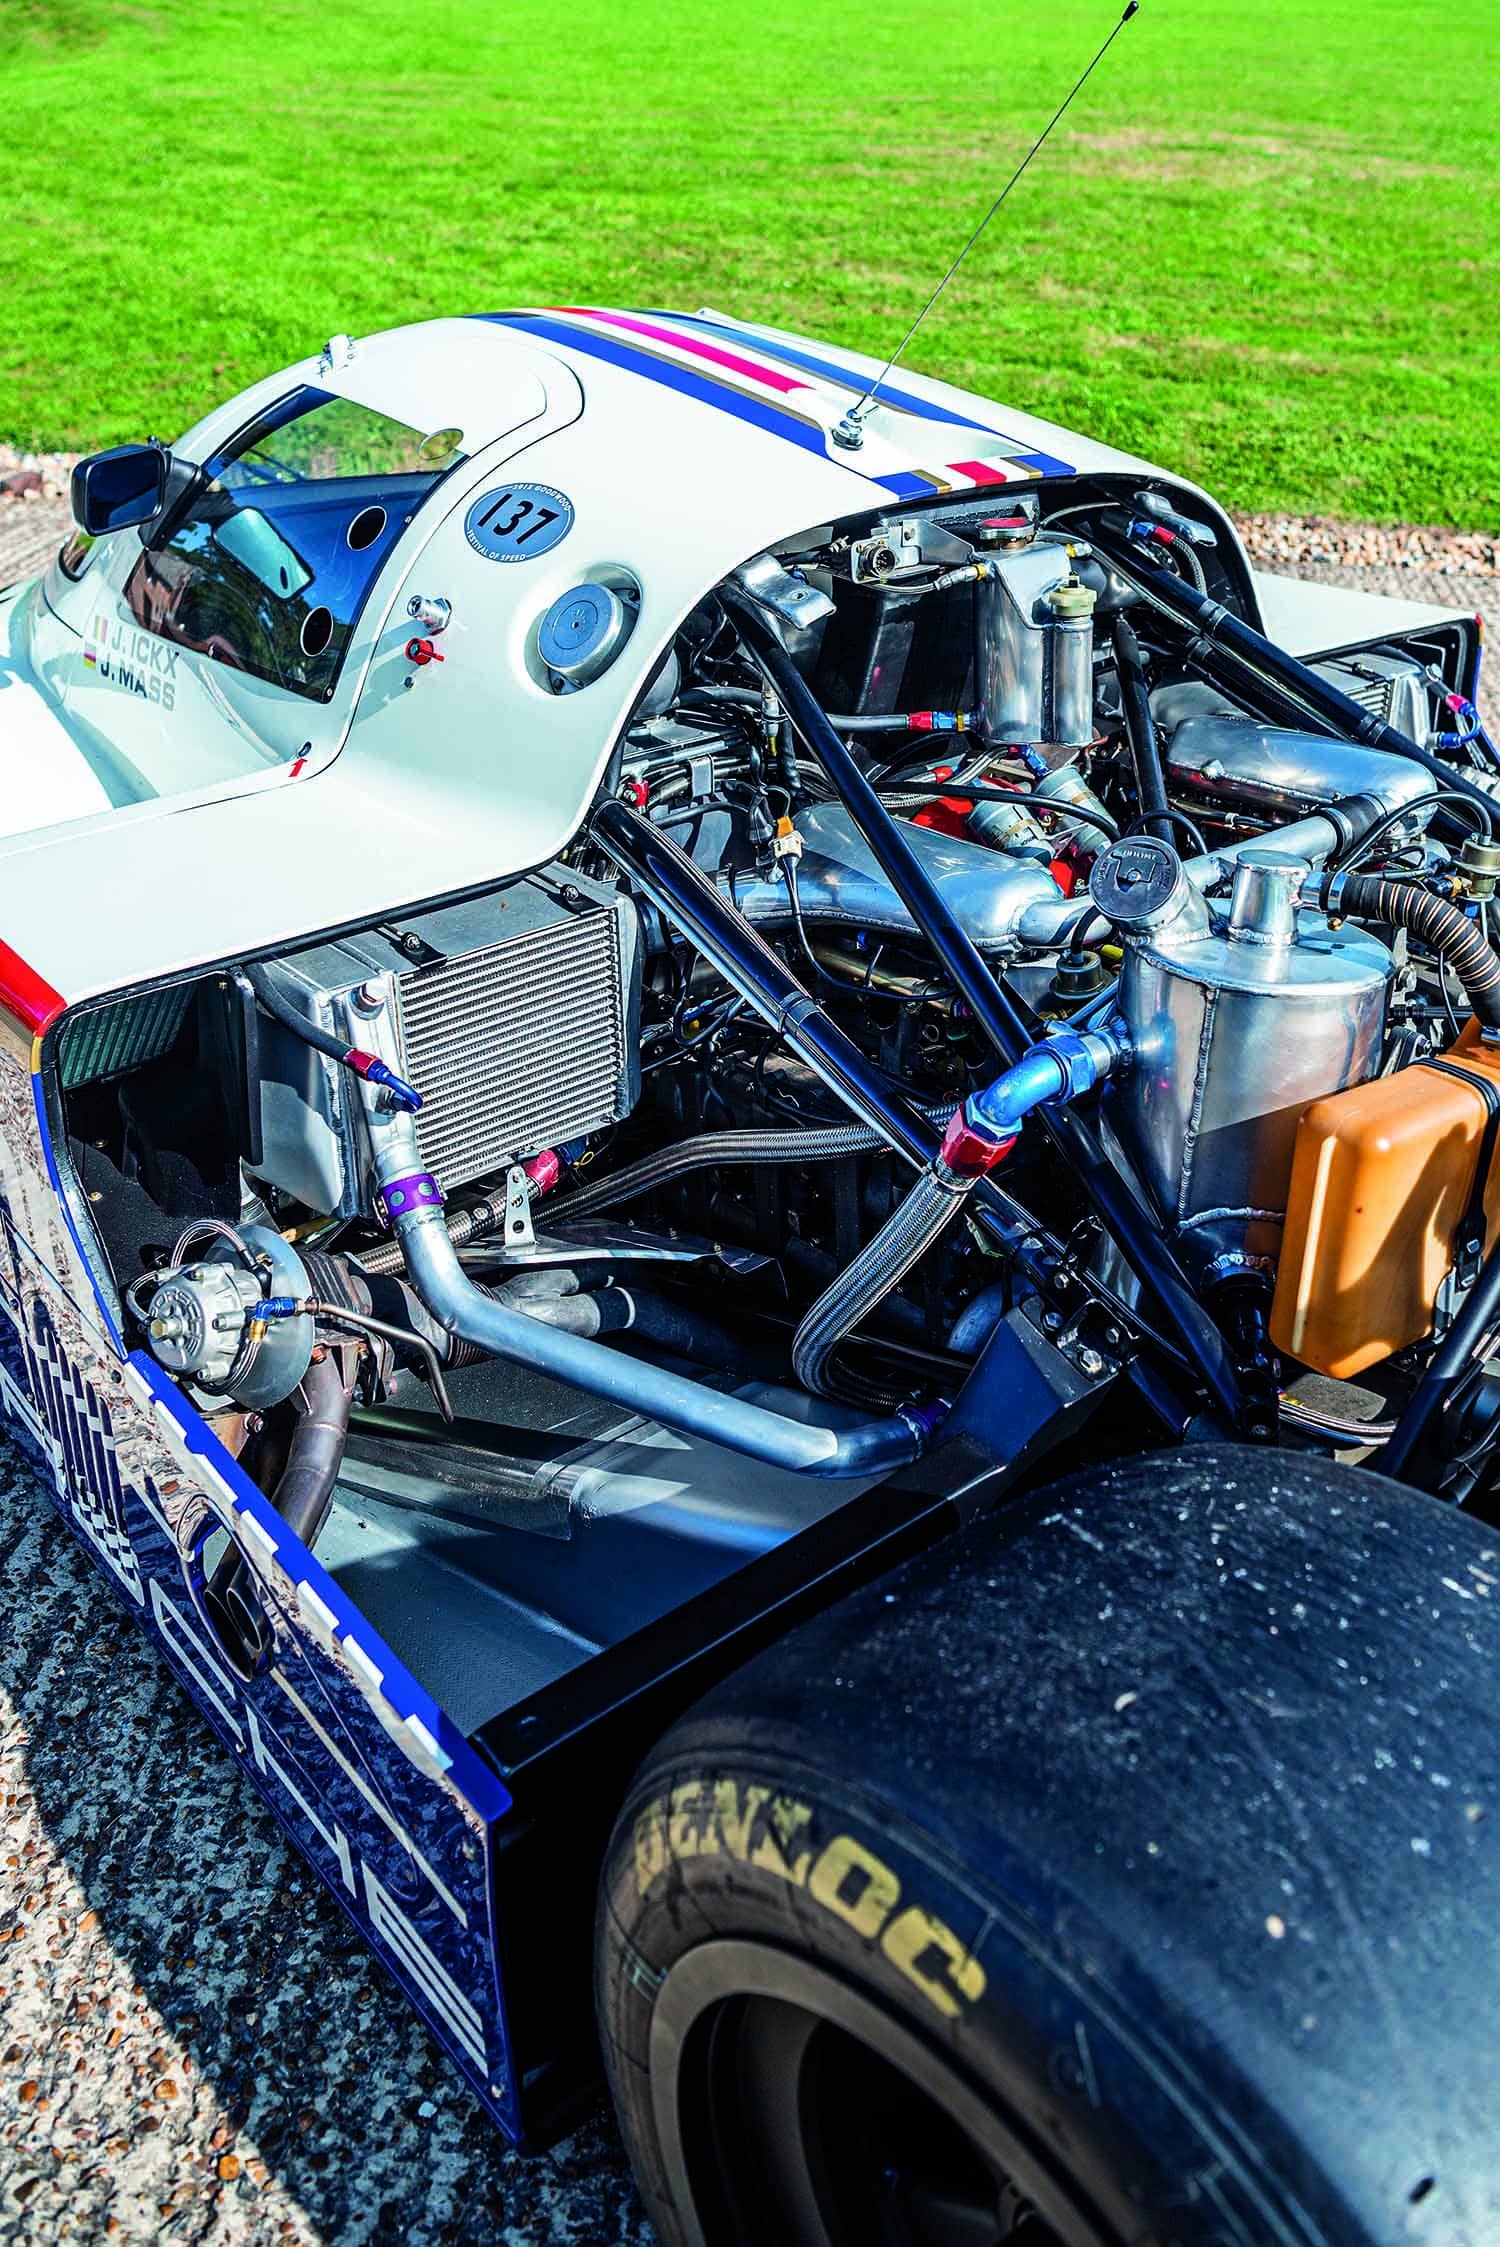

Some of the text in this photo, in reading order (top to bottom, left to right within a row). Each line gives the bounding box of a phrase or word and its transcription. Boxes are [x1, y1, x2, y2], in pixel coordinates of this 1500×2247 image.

[534, 484, 572, 511] GOODWOOD
[477, 493, 560, 544] 137
[466, 529, 487, 556] FESTIVAL
[489, 551, 499, 560] OF
